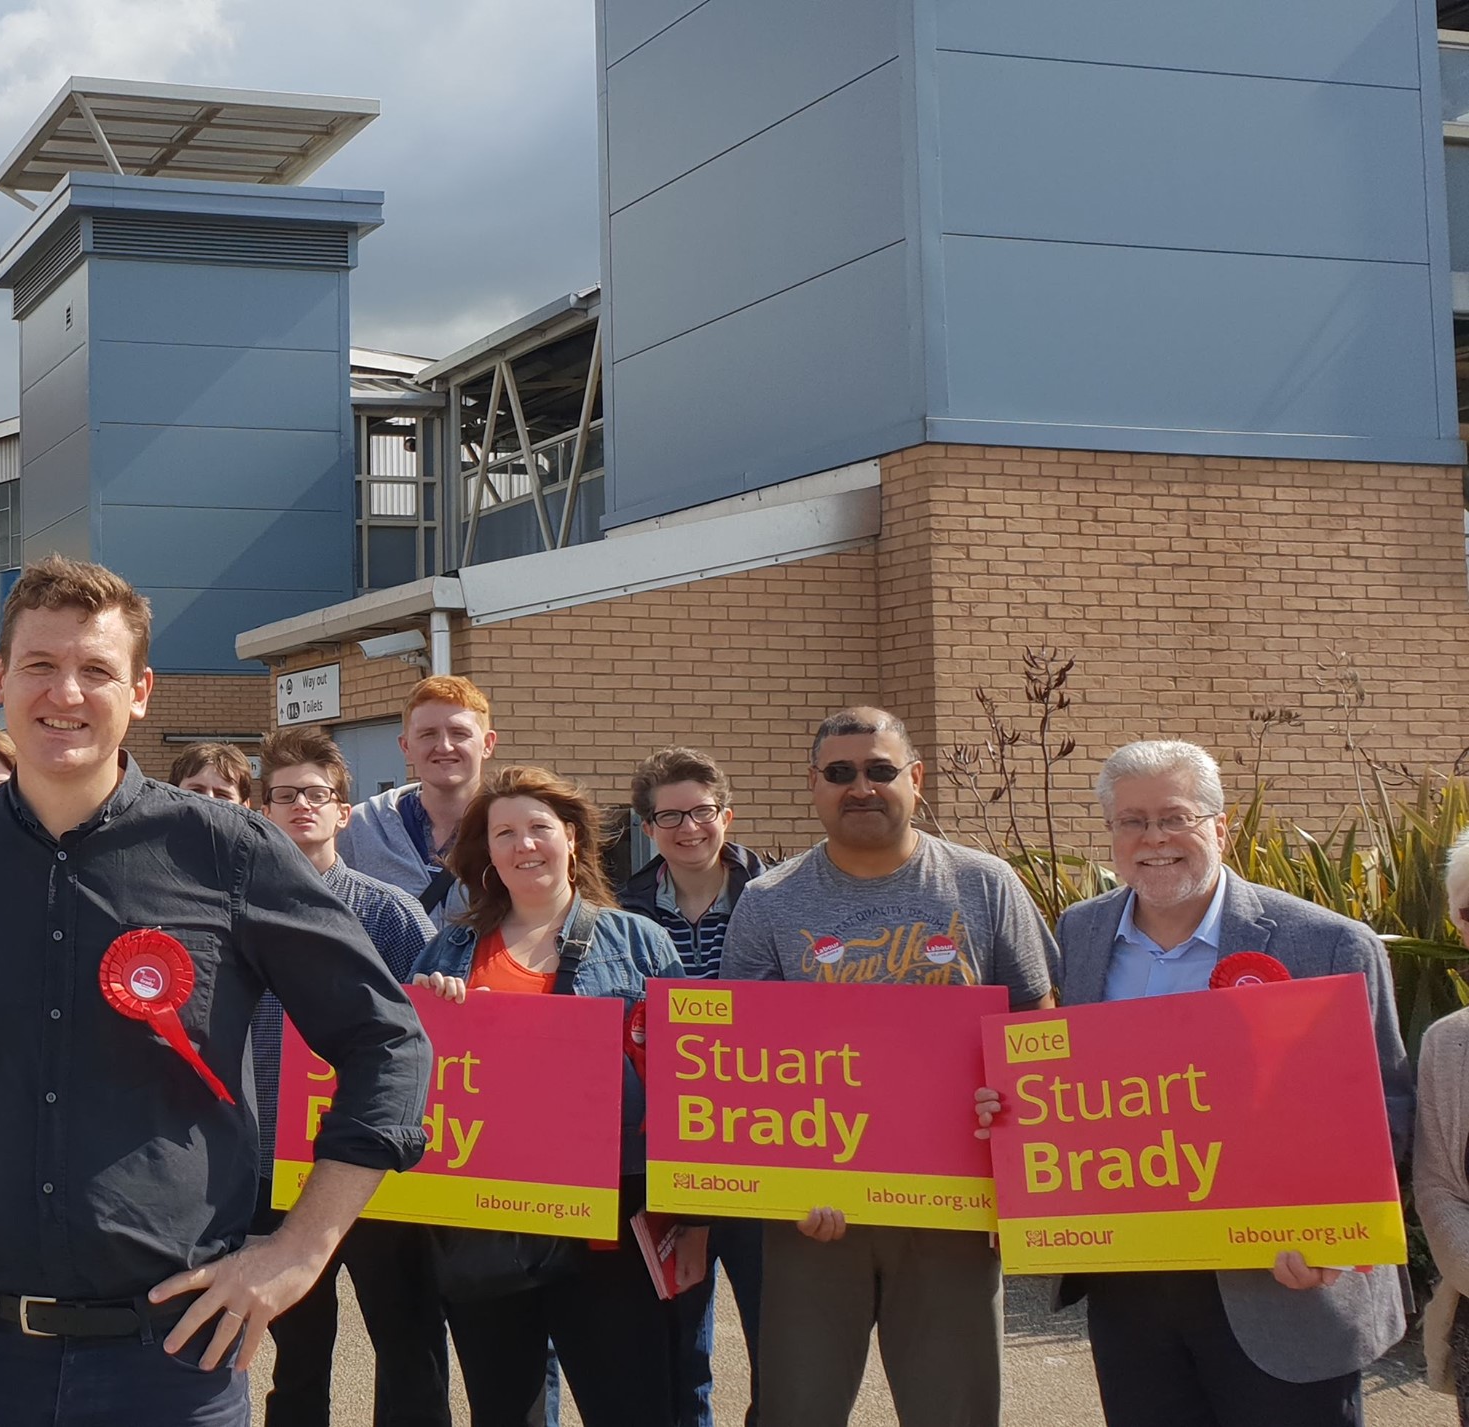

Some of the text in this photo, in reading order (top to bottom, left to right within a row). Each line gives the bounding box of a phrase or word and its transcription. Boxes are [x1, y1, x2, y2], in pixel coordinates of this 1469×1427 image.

[302, 672, 328, 691] Way out
[302, 699, 323, 713] Toilets
[855, 905, 904, 922] QUALITY
[814, 942, 839, 955] Labour
[926, 943, 954, 952] Labour
[672, 996, 728, 1018] Vote
[1008, 1032, 1066, 1054] Vote
[675, 1034, 862, 1087] Stuart
[1016, 1063, 1212, 1126] Stuart
[678, 1094, 870, 1164] Brady
[1023, 1129, 1223, 1202] Brady
[691, 1174, 761, 1193] Labour
[475, 1194, 591, 1219] labour.org.uk
[867, 1187, 992, 1211] labour.org.uk
[1043, 1229, 1114, 1248] Labour
[1228, 1222, 1370, 1246] labour.org.uk
